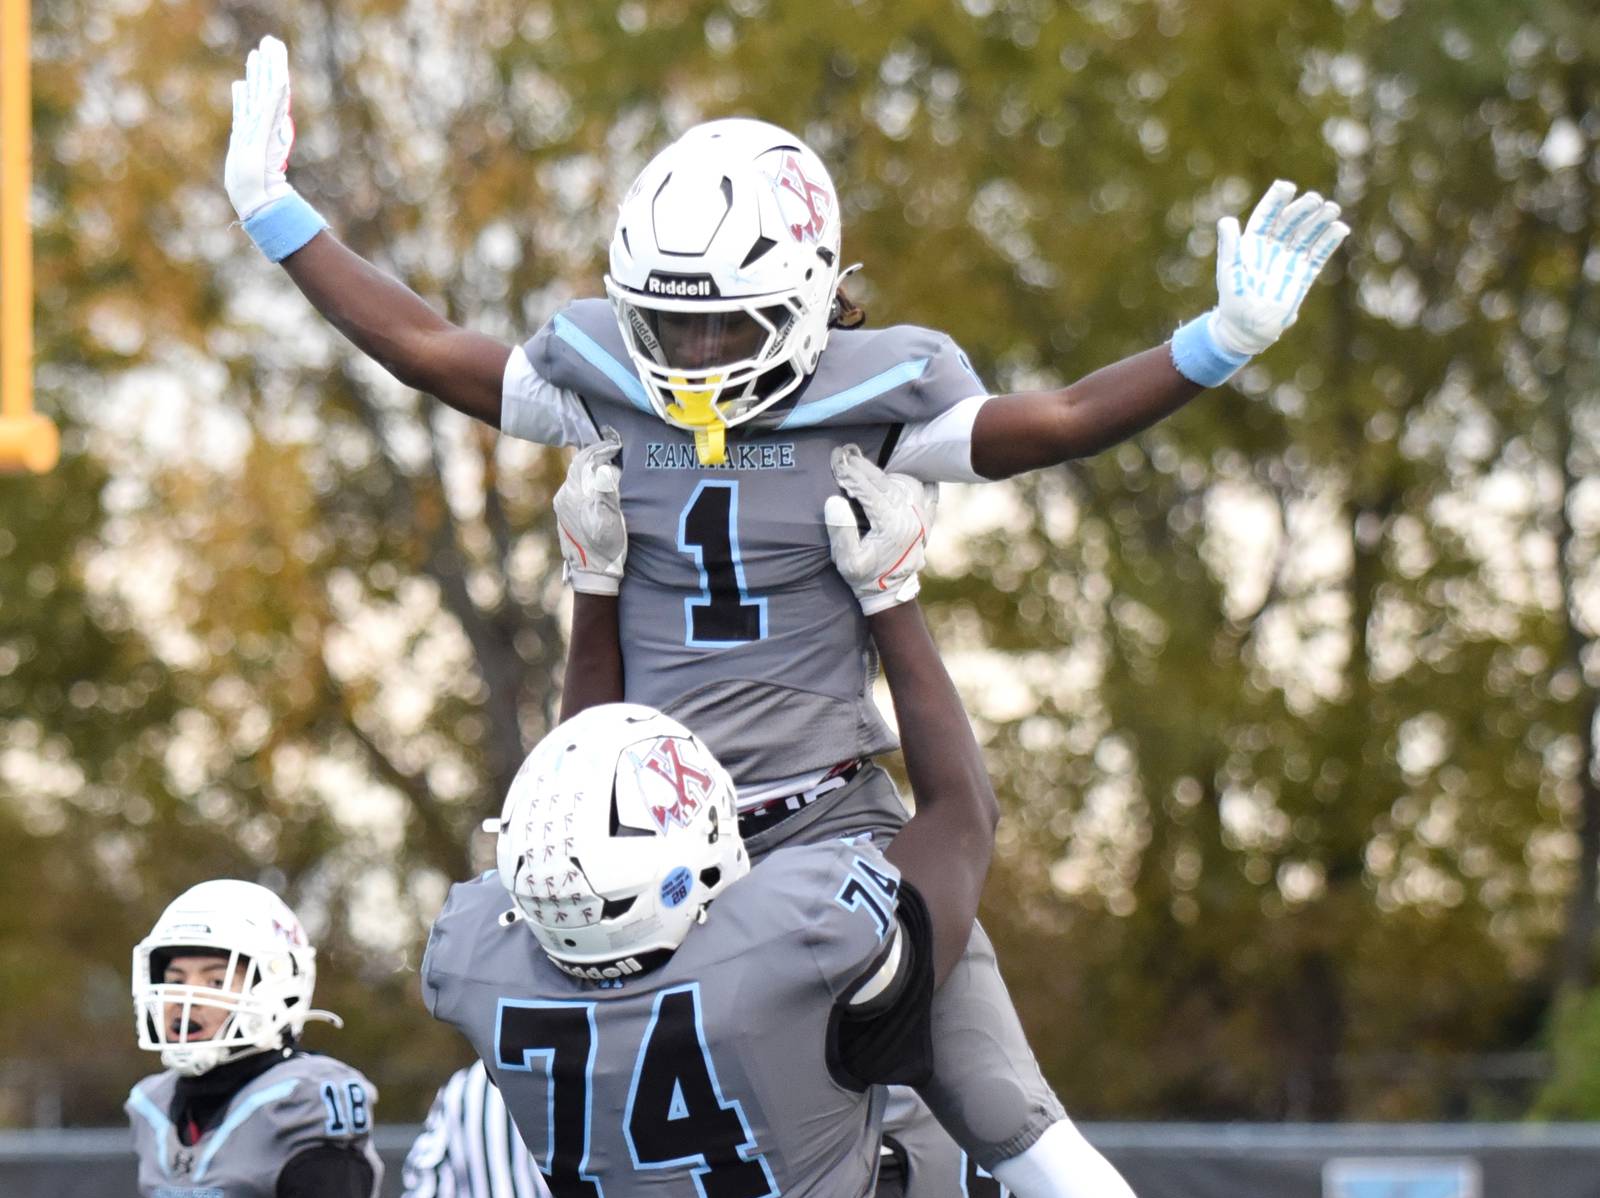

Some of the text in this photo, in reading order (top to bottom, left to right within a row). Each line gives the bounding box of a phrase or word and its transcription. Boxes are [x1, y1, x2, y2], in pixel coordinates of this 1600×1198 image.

[649, 277, 711, 296] Riddell
[629, 308, 658, 350] Riddell
[645, 442, 795, 470] KANAKEE
[677, 479, 769, 649] 1
[834, 856, 900, 943] 74
[320, 1080, 368, 1136] 18
